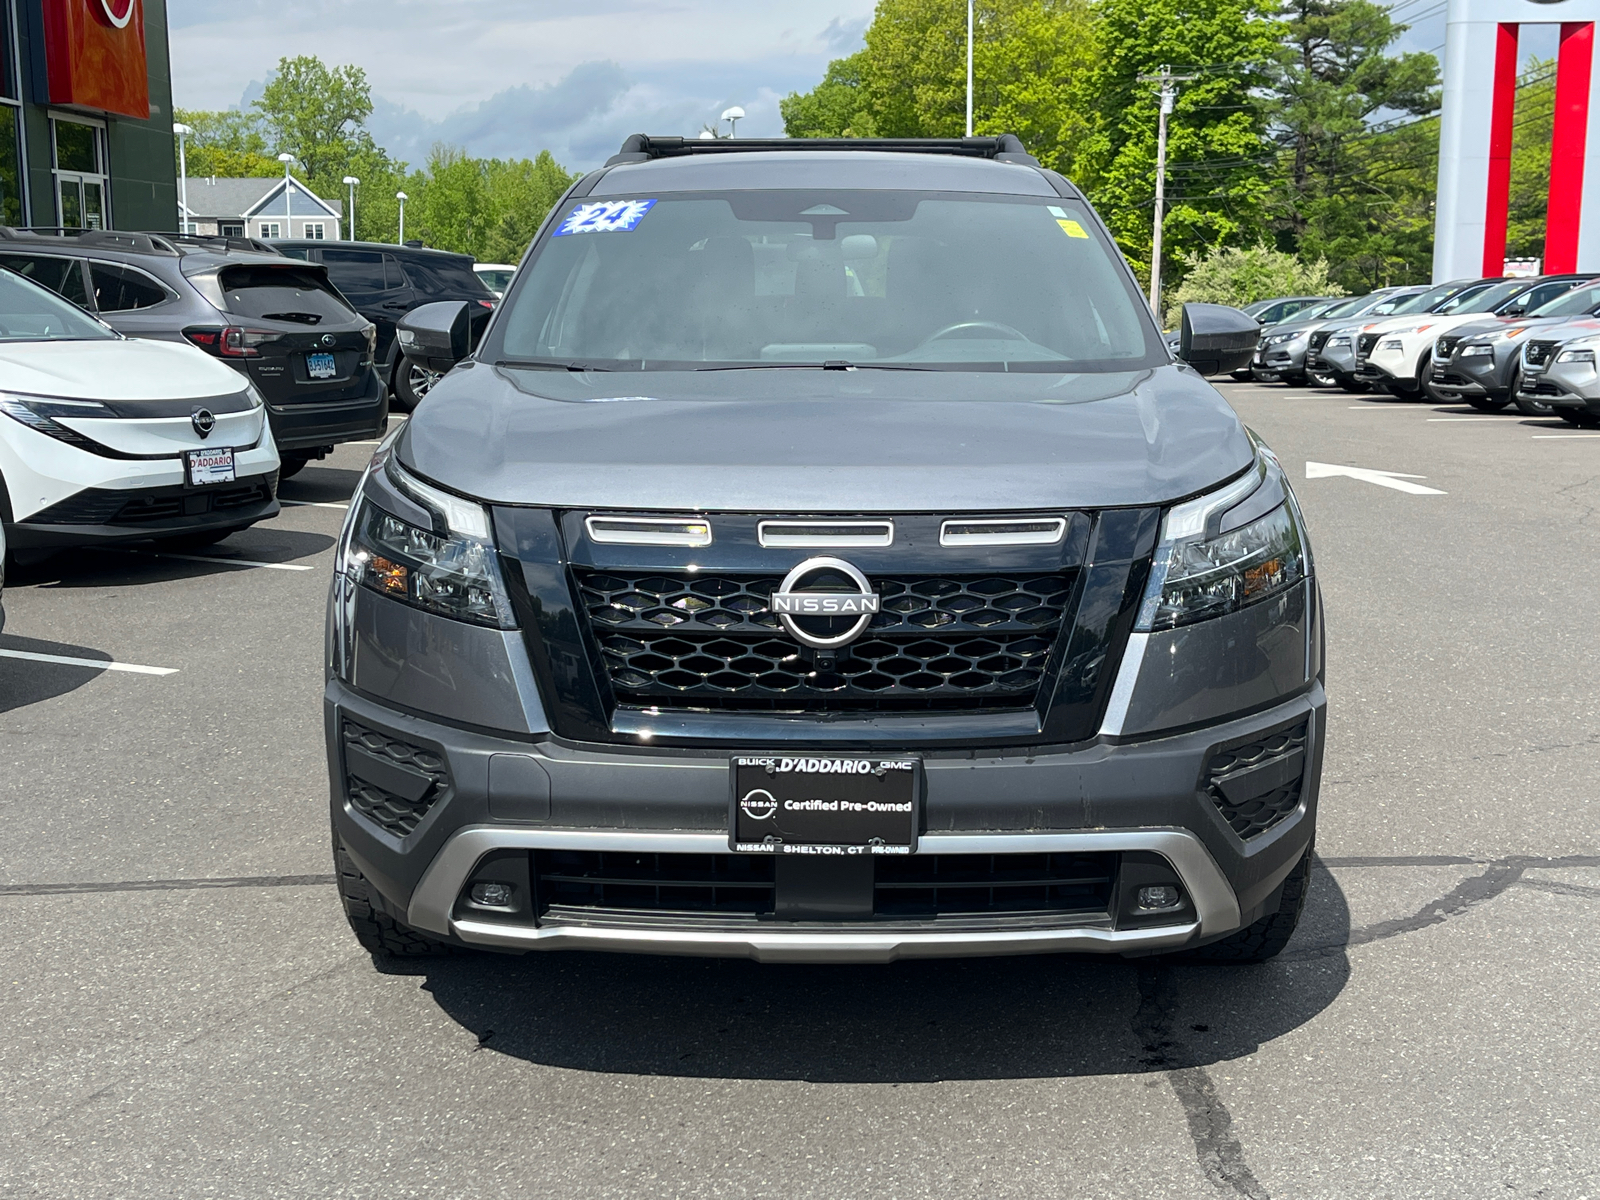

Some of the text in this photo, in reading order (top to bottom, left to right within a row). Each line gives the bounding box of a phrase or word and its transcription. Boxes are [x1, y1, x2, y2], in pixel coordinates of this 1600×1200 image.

[578, 206, 631, 225] 24
[190, 456, 232, 469] D'ADDARIO
[774, 597, 877, 612] NISSAN
[738, 758, 912, 774] BUICK D'ADDARIO GMC
[740, 800, 778, 808] NISSAN
[784, 800, 912, 812] Certified Pre-Owned
[736, 844, 910, 855] NISSAN SHELTON, CT PRE-OWNED
